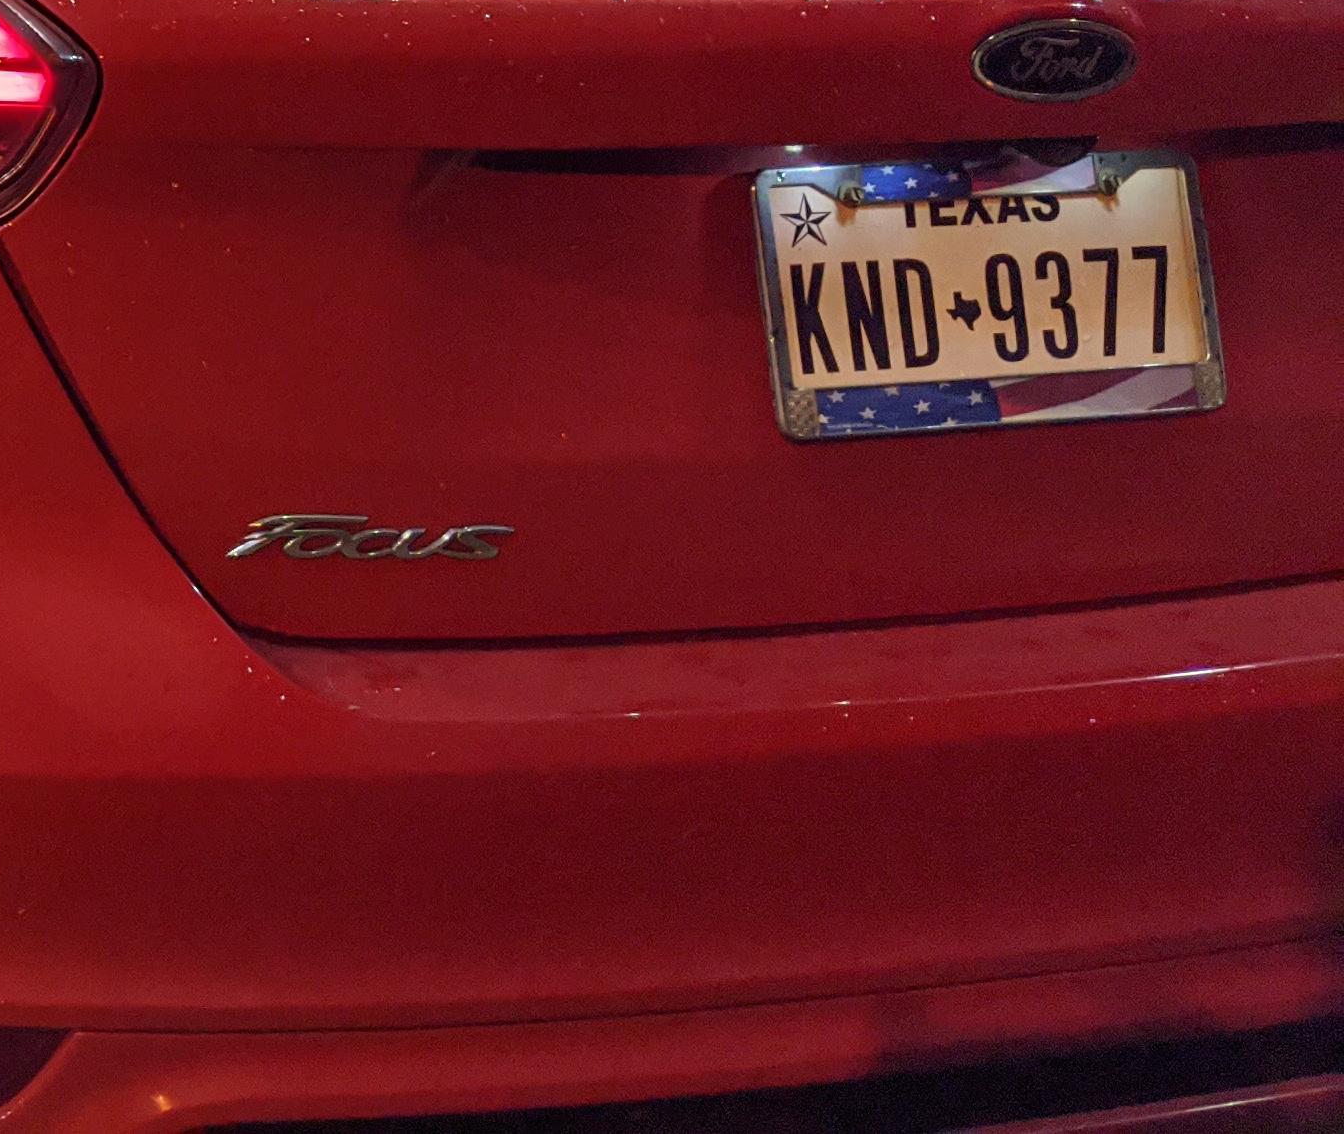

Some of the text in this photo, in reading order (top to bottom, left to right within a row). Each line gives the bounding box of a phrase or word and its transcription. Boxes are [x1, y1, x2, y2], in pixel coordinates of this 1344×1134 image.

[1013, 36, 1105, 81] Ford
[901, 194, 1062, 229] TEXAS
[789, 245, 1169, 375] KND 9377
